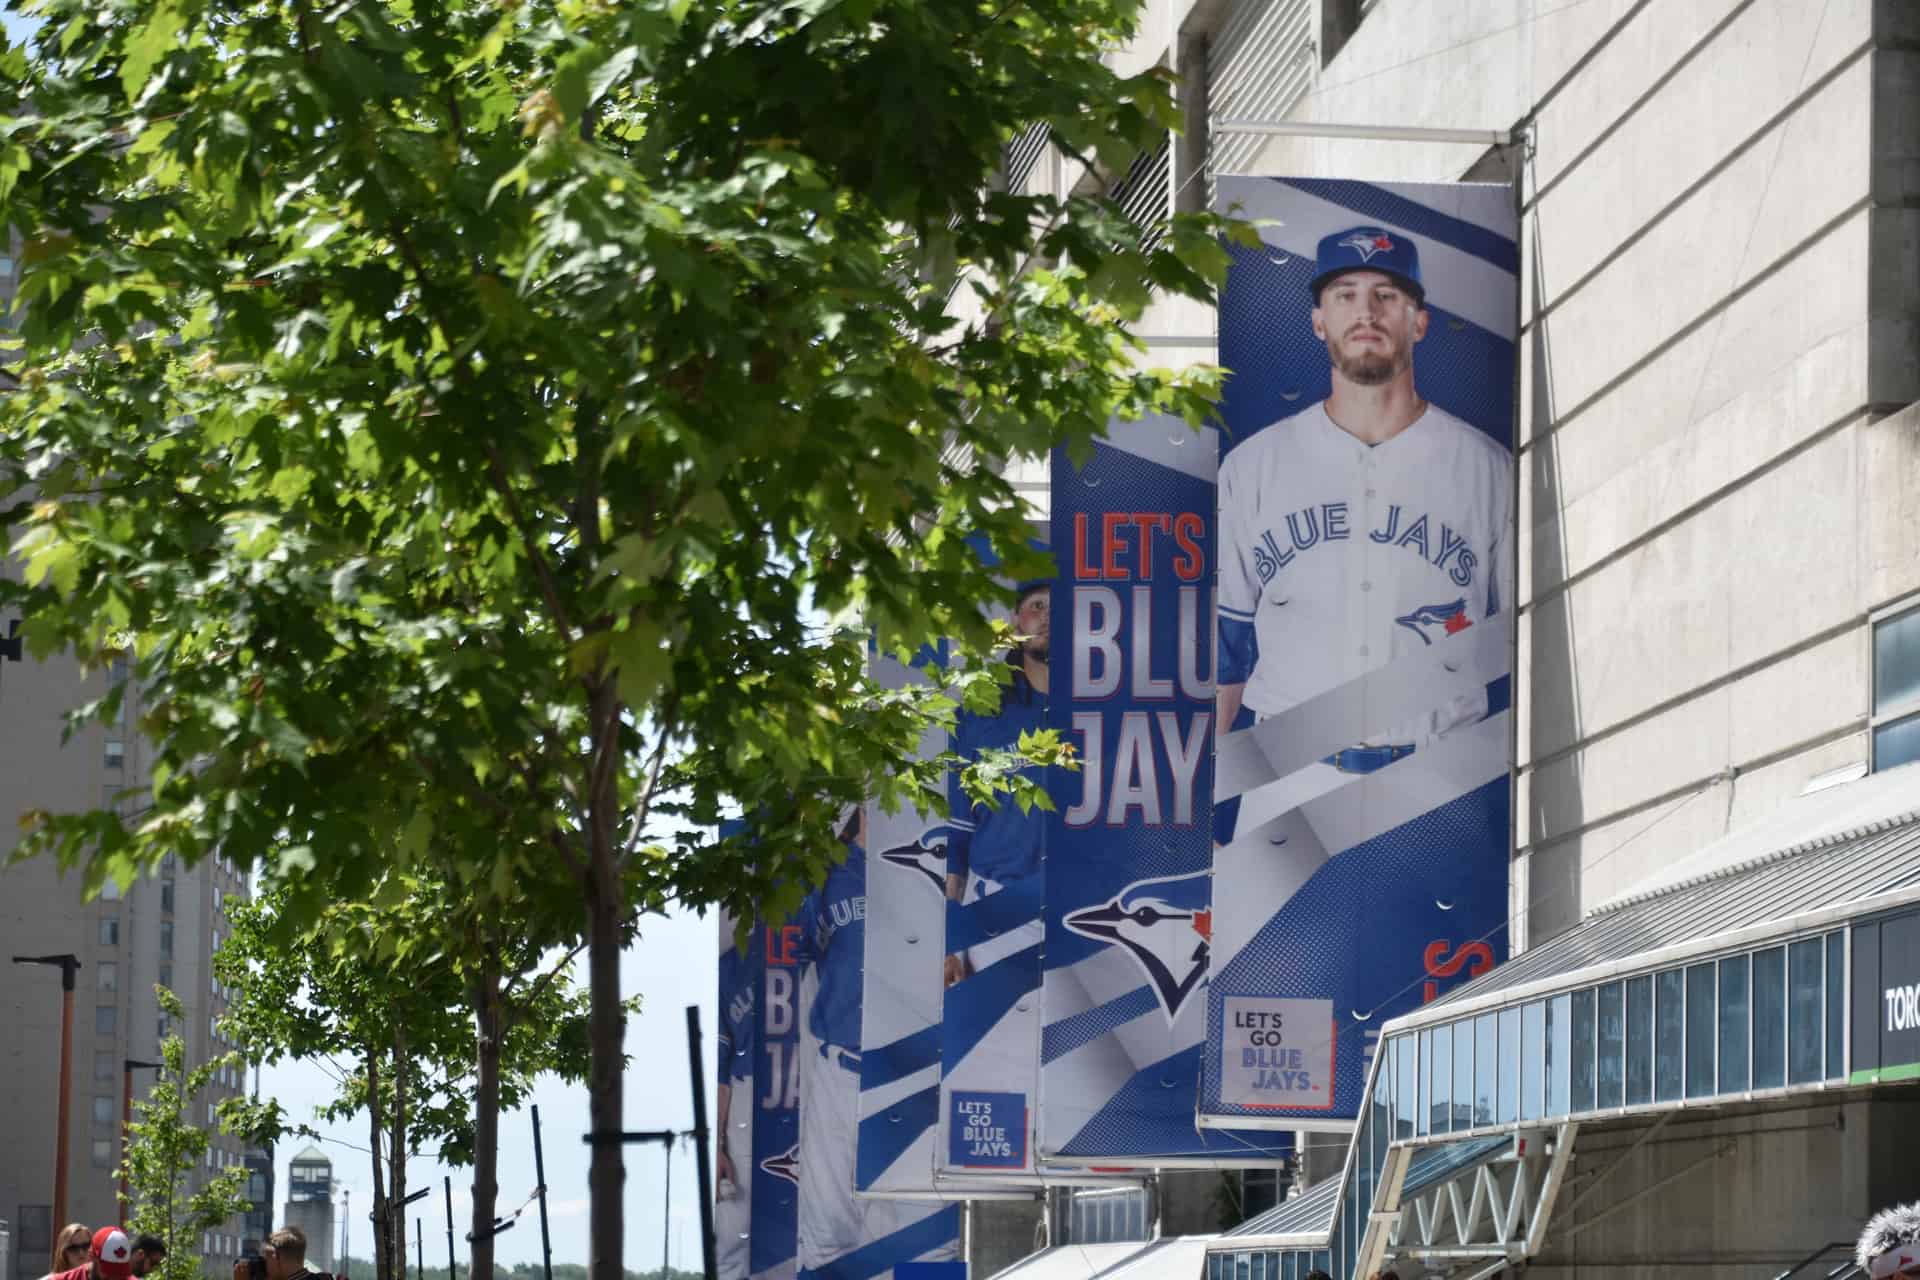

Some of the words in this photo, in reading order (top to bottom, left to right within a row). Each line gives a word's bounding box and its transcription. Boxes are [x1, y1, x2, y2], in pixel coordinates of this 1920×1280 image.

[1073, 511, 1205, 581] LET'S
[1253, 502, 1351, 588] BLUE
[1369, 504, 1479, 588] JAYS
[766, 924, 802, 966] LE
[1235, 1011, 1282, 1029] LET'S
[1250, 1030, 1282, 1047] GO
[1242, 1047, 1303, 1069] BLUE
[969, 1114, 992, 1127] GO
[963, 1126, 1006, 1142] BLUE
